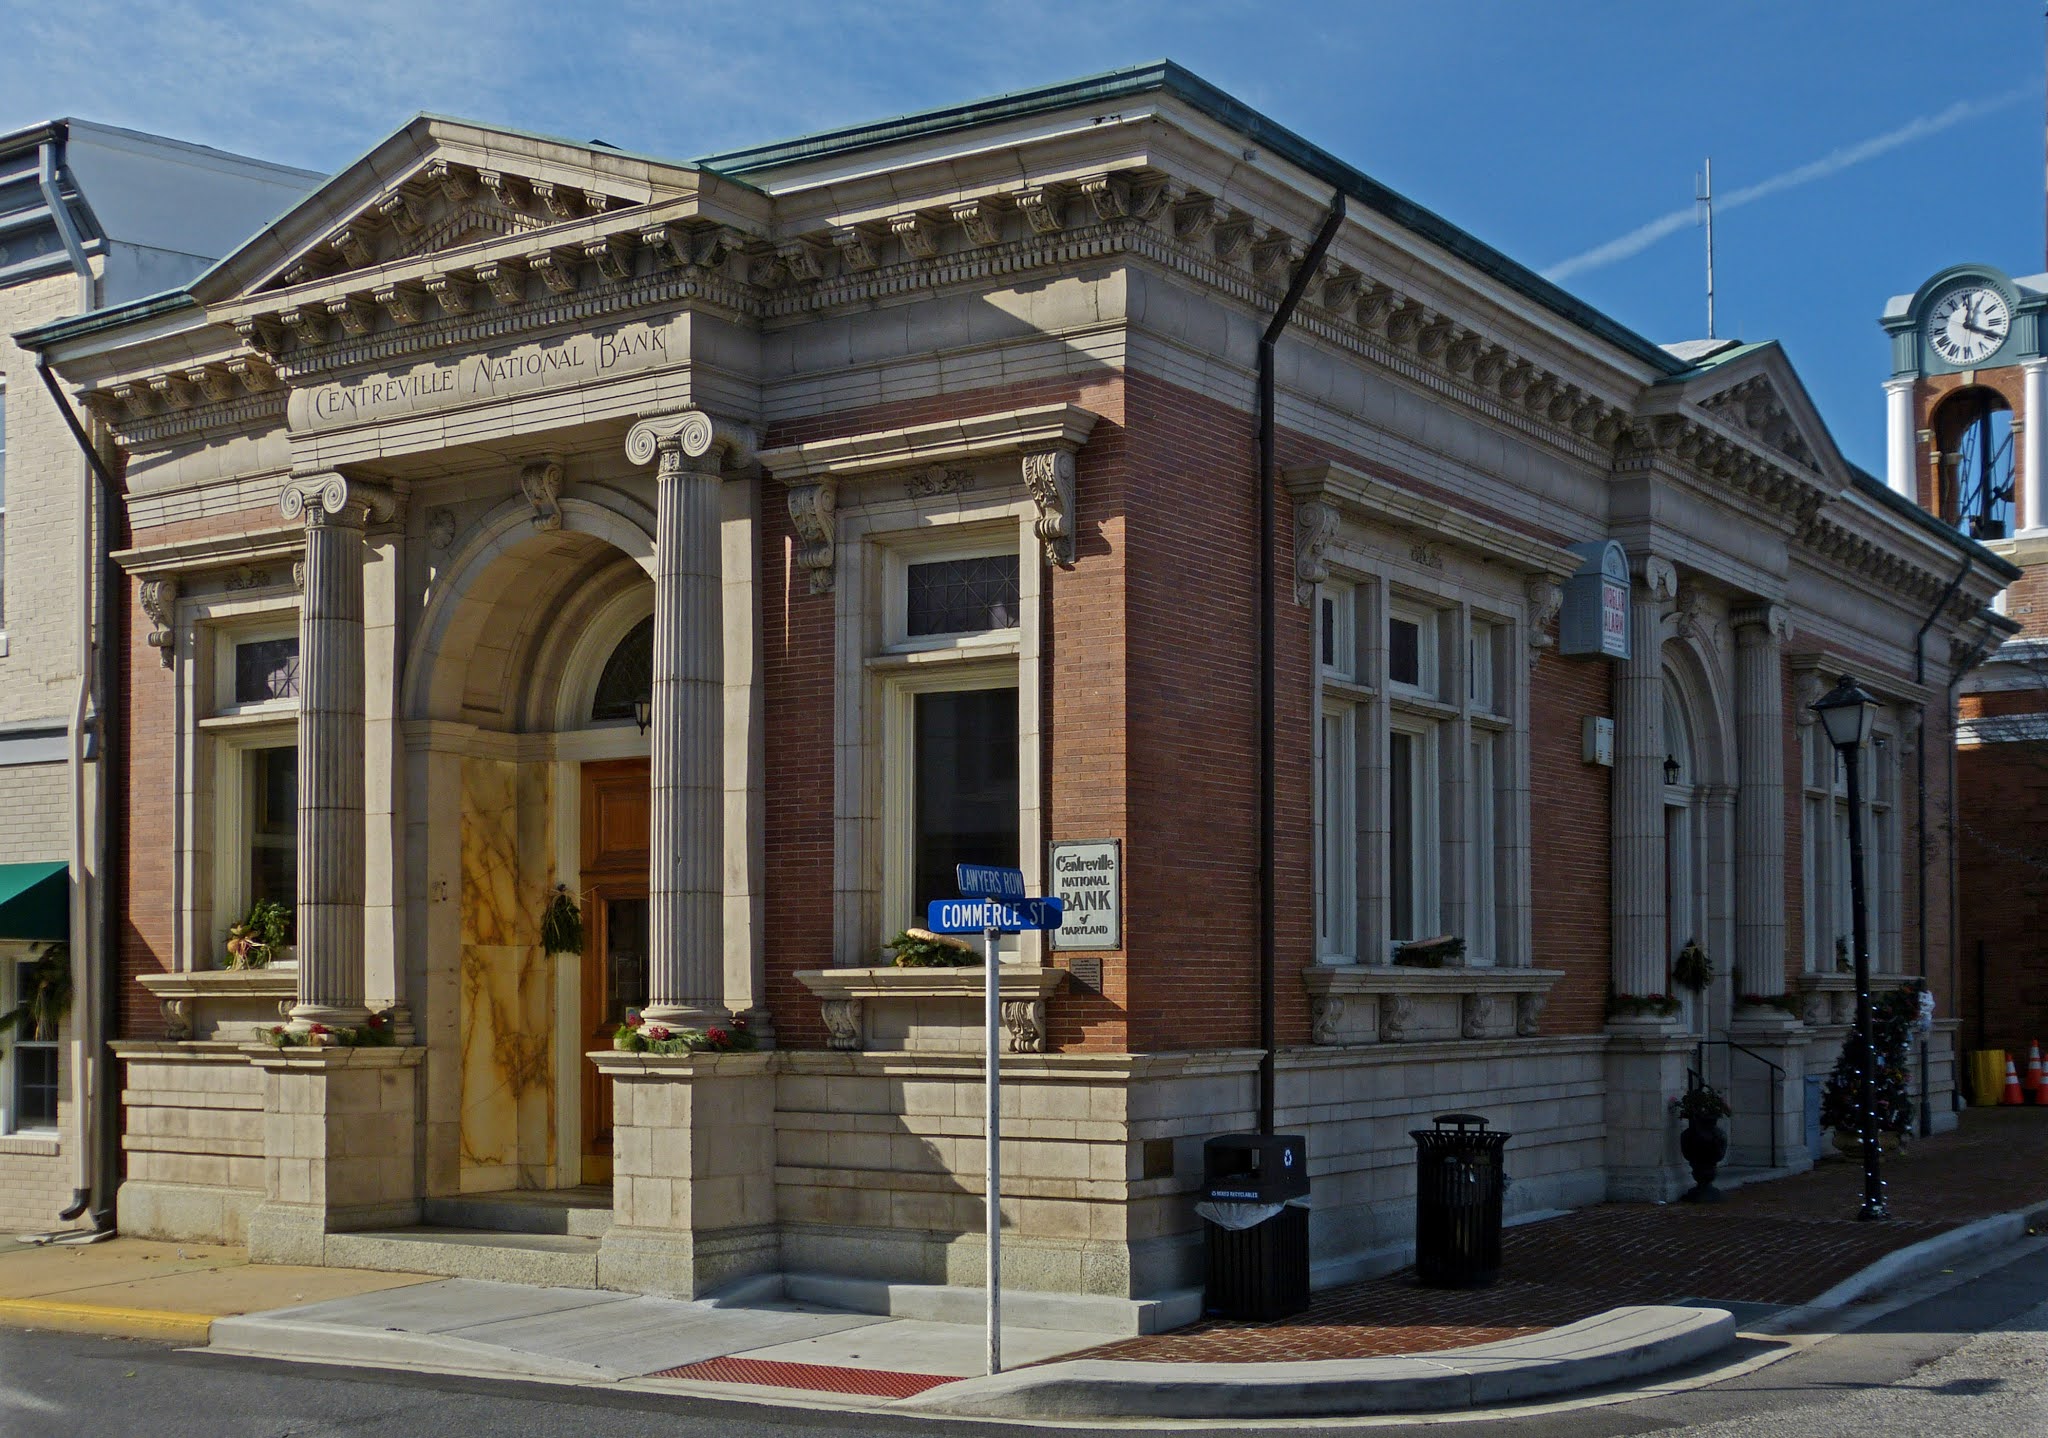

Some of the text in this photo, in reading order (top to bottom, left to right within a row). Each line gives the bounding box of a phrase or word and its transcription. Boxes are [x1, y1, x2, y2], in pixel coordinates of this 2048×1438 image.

[316, 327, 665, 420] CENTREVILLE NATIONAL BANK
[1055, 854, 1114, 873] Centreville
[959, 868, 1024, 895] LAWYERS ROW
[1061, 875, 1110, 887] NATIONAL
[1060, 889, 1112, 912] BANK
[942, 901, 1047, 928] COMMERCE ST
[1079, 913, 1091, 925] of
[1061, 925, 1109, 936] MARYLAND
